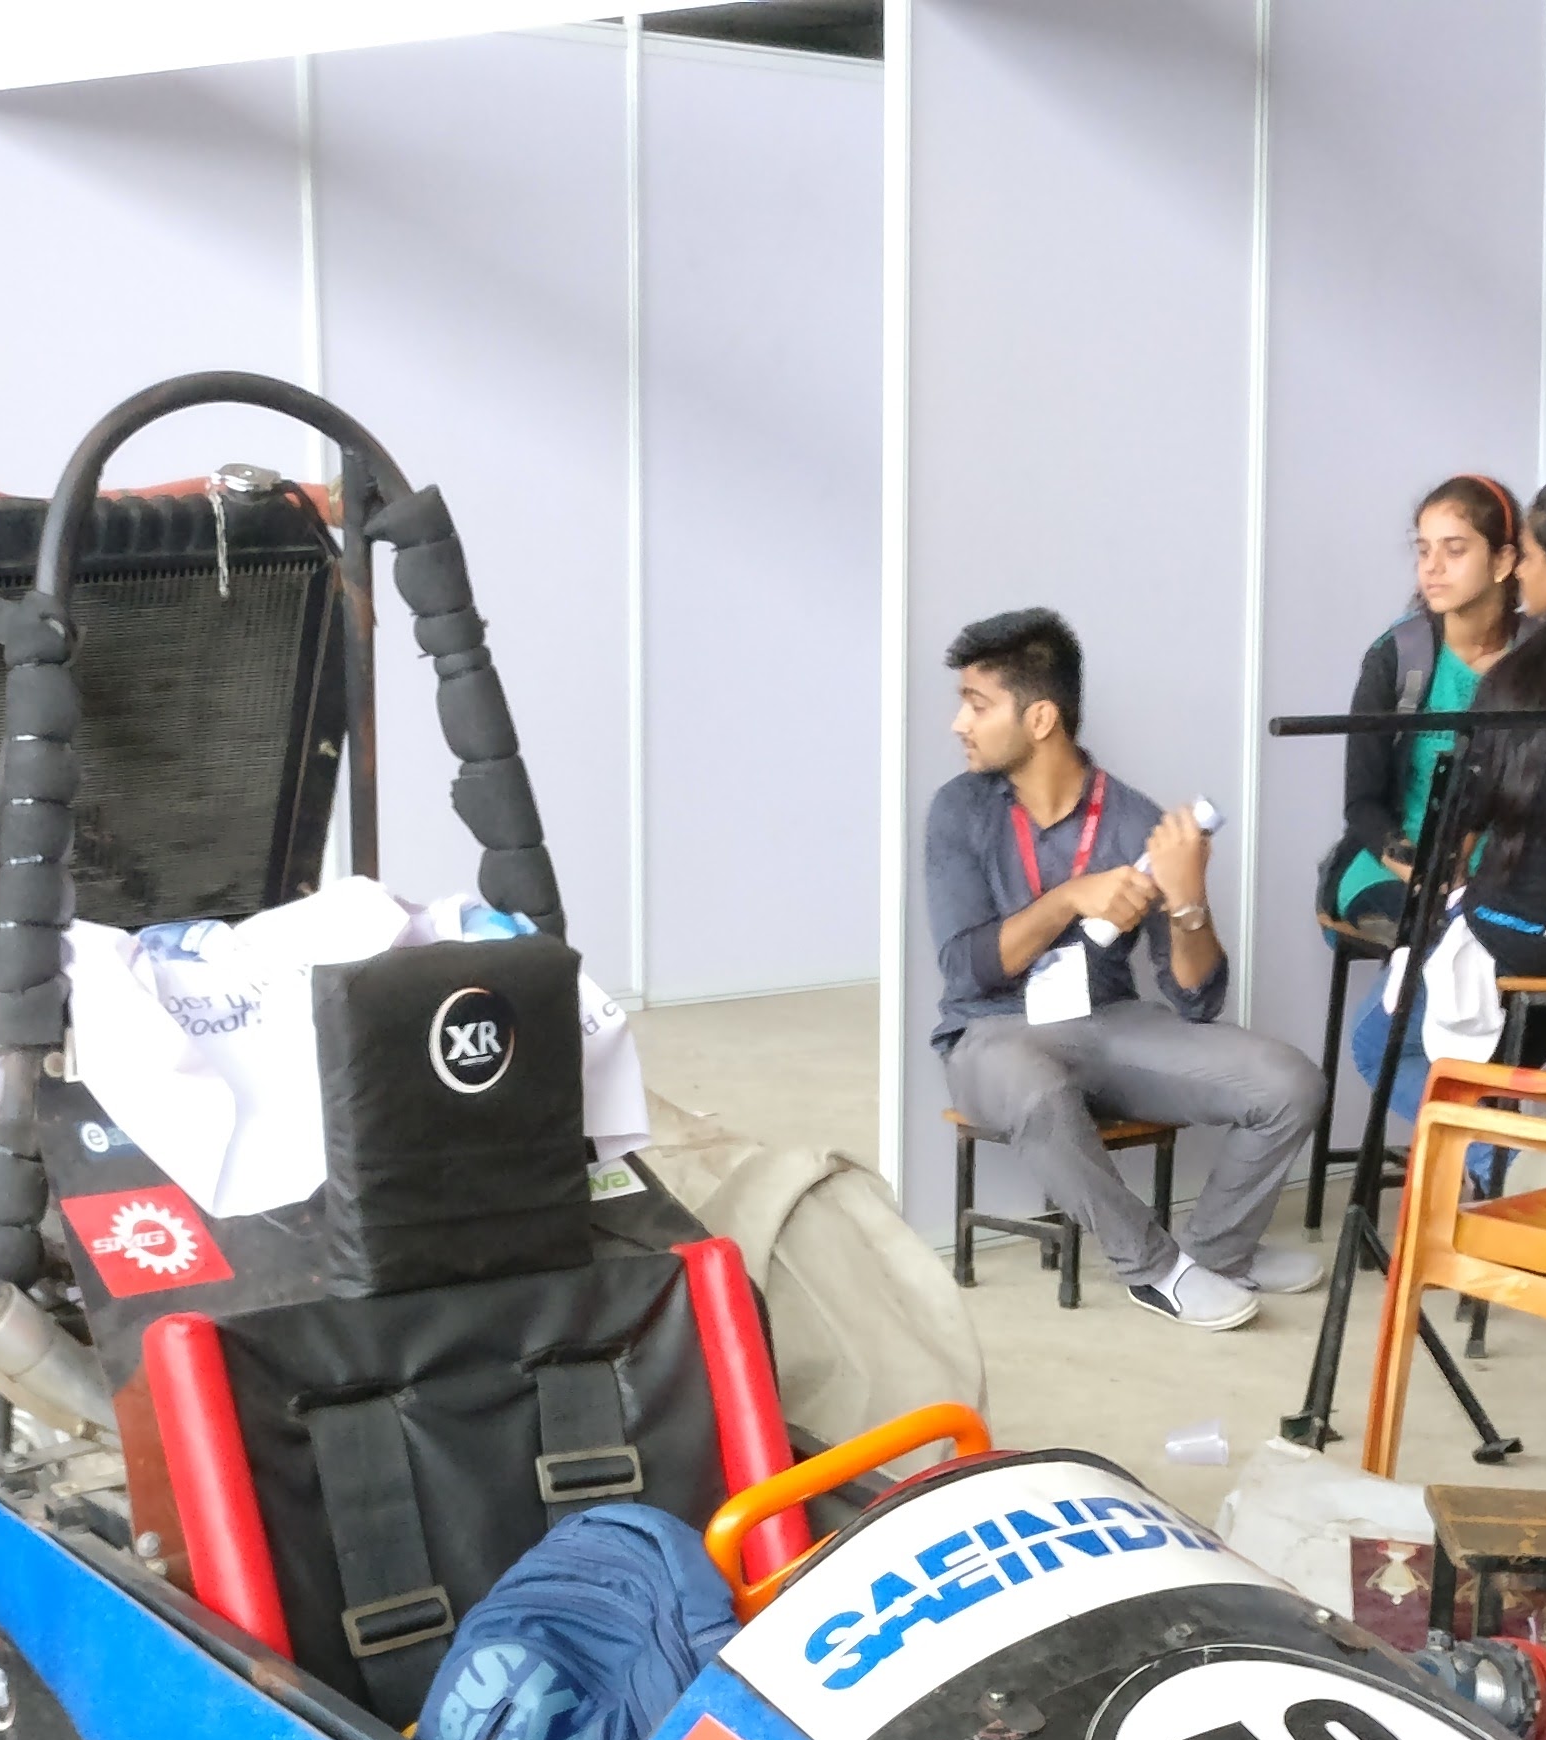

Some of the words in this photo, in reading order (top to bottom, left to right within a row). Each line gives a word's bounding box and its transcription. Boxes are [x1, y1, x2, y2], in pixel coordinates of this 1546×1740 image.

[445, 1020, 503, 1061] XR
[91, 1230, 166, 1255] SMG
[804, 1496, 1221, 1691] SAEINDI
